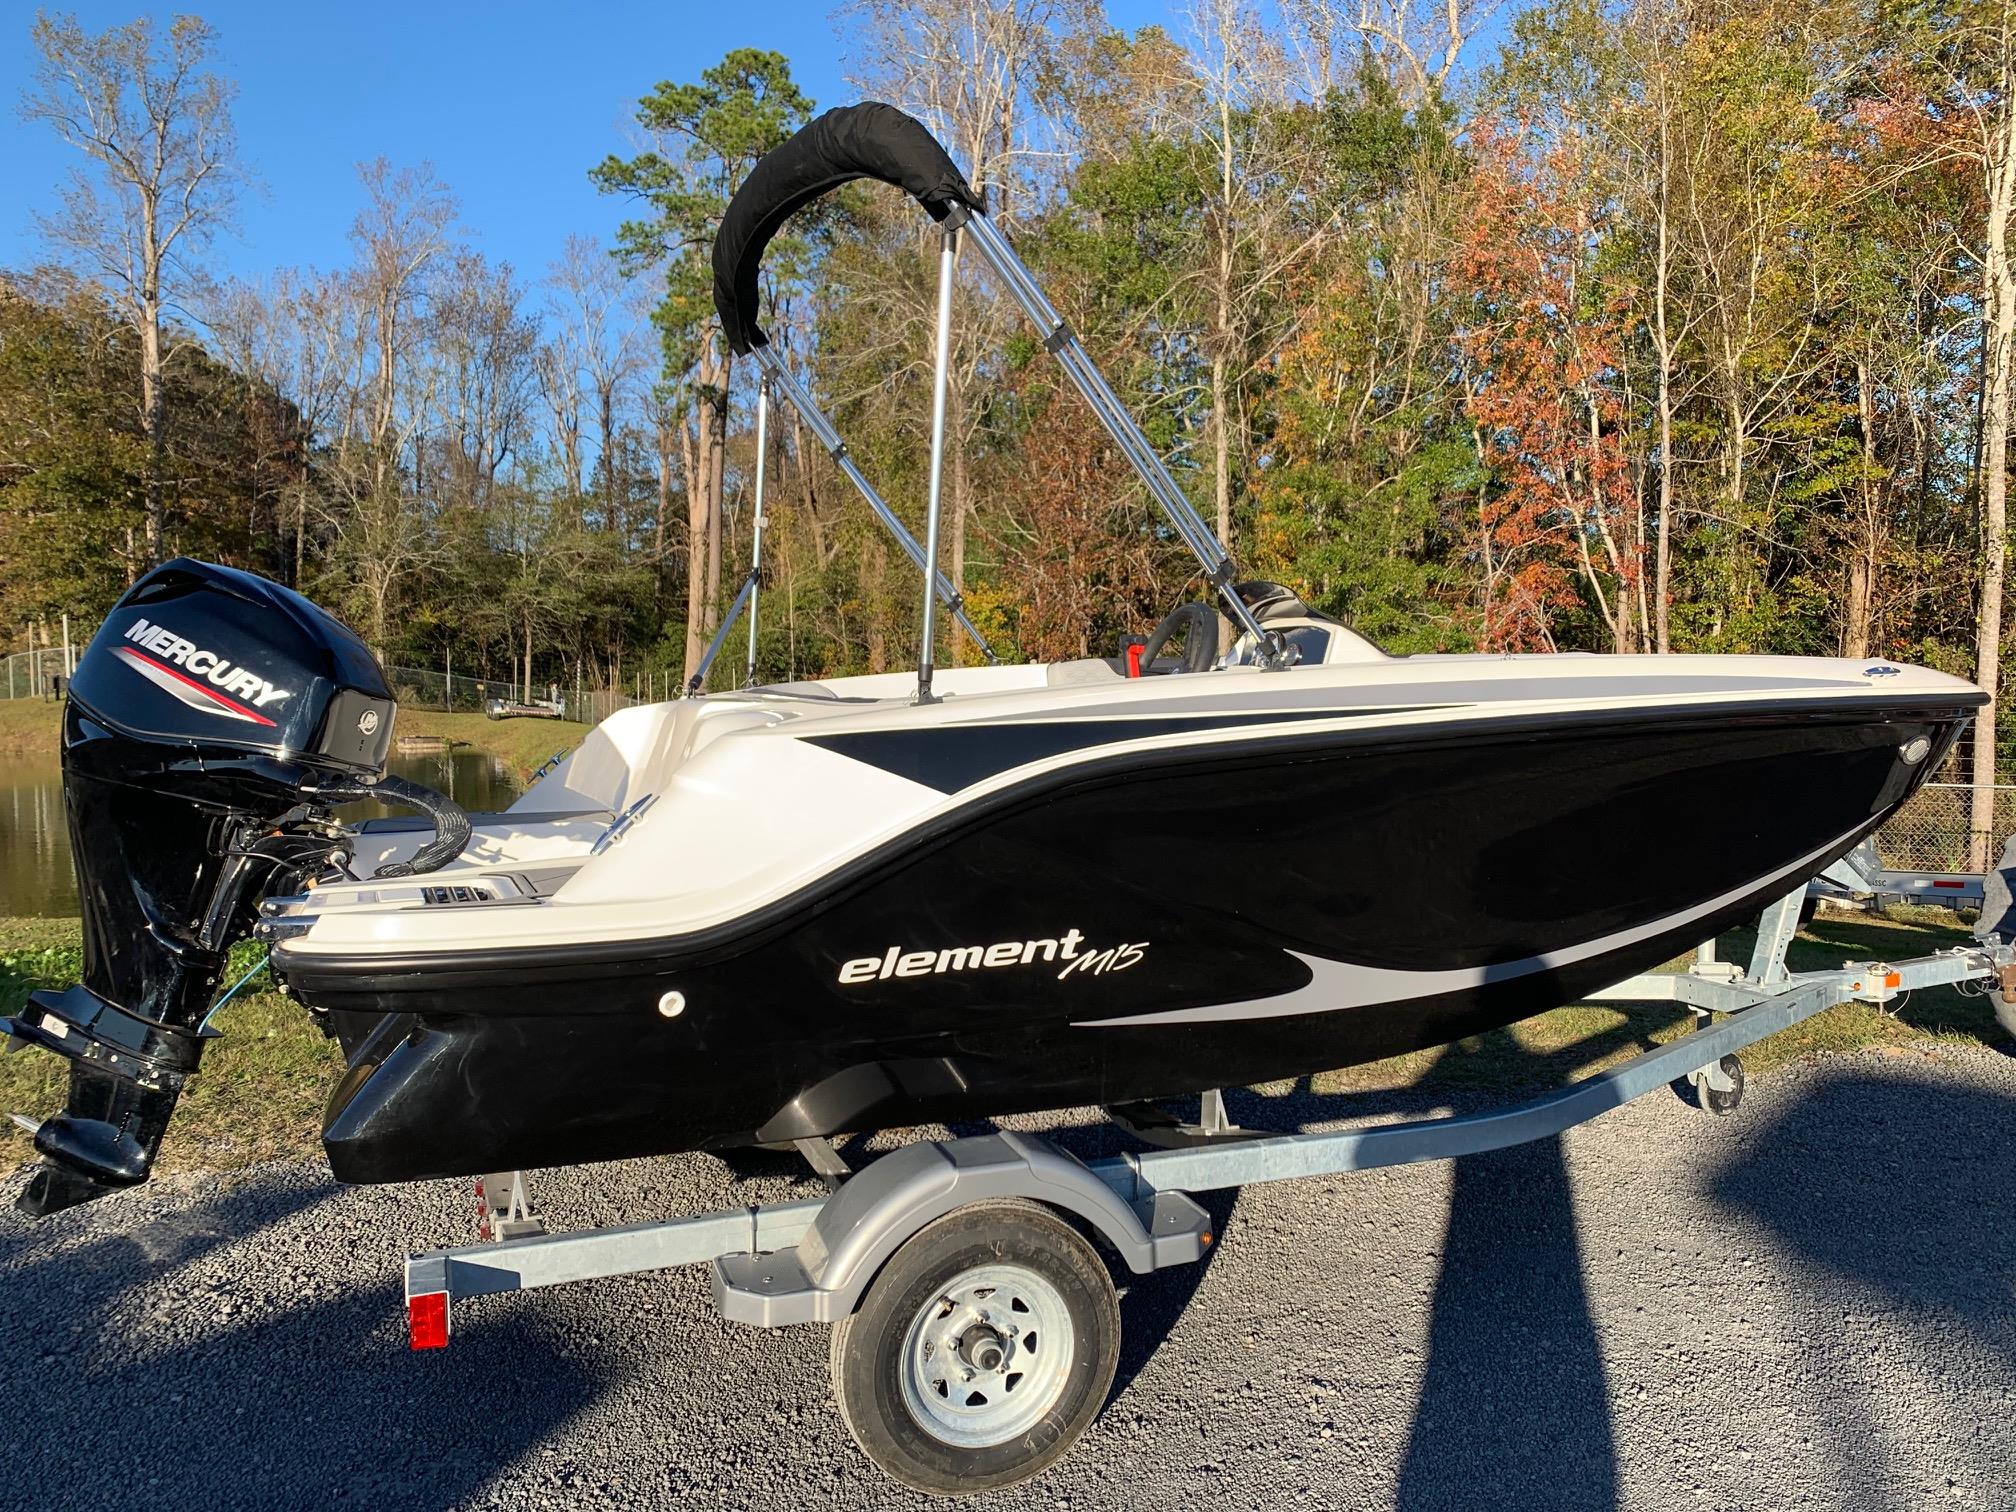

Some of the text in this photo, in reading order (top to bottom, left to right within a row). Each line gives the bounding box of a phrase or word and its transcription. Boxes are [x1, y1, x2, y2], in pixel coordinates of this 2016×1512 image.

[124, 618, 290, 707] MERCURY
[837, 928, 1150, 984] element M15
